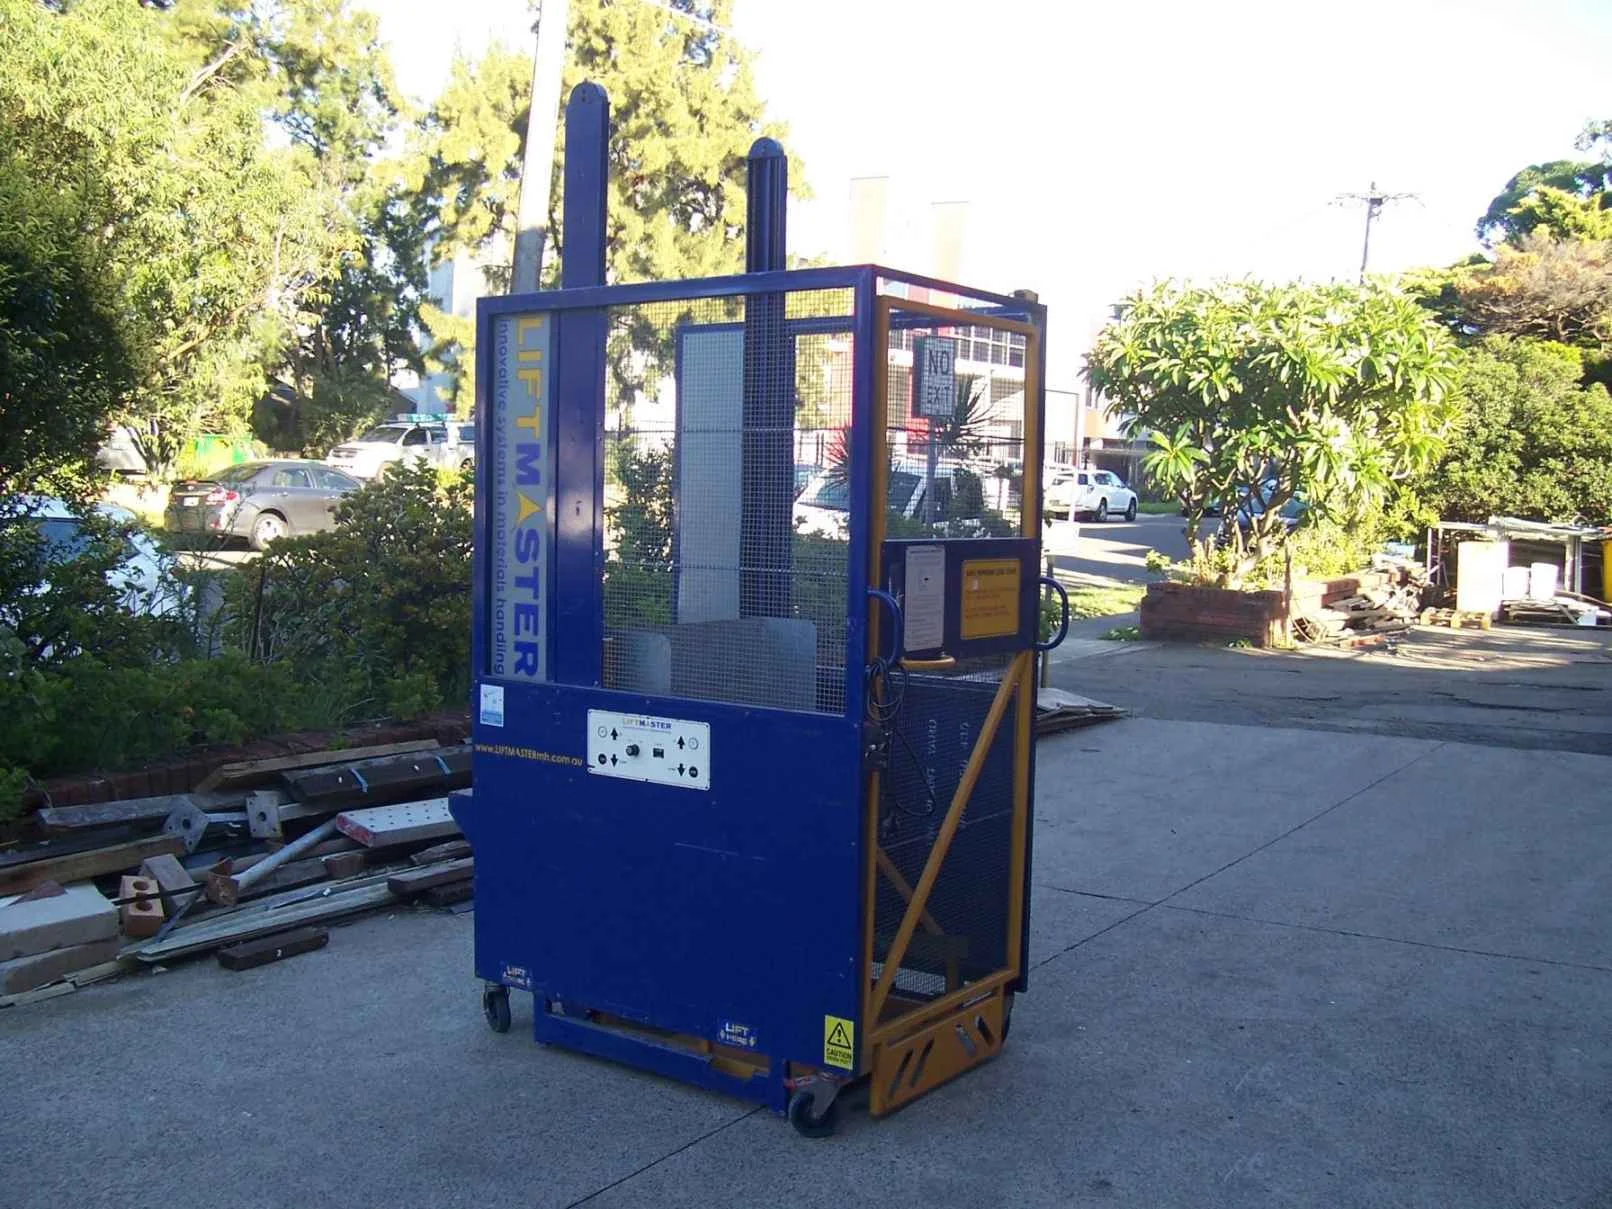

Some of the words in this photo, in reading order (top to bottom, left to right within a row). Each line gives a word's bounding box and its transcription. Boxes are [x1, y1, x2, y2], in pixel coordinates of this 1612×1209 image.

[497, 319, 511, 411] innovative
[928, 350, 950, 375] NO
[927, 384, 951, 404] EXIT
[496, 416, 508, 486] systems
[497, 491, 507, 507] in
[514, 317, 543, 677] LIFTMASTER
[495, 512, 508, 593] materials
[493, 599, 507, 675] handling
[506, 965, 526, 978] LIFT
[725, 1022, 749, 1037] LIFT
